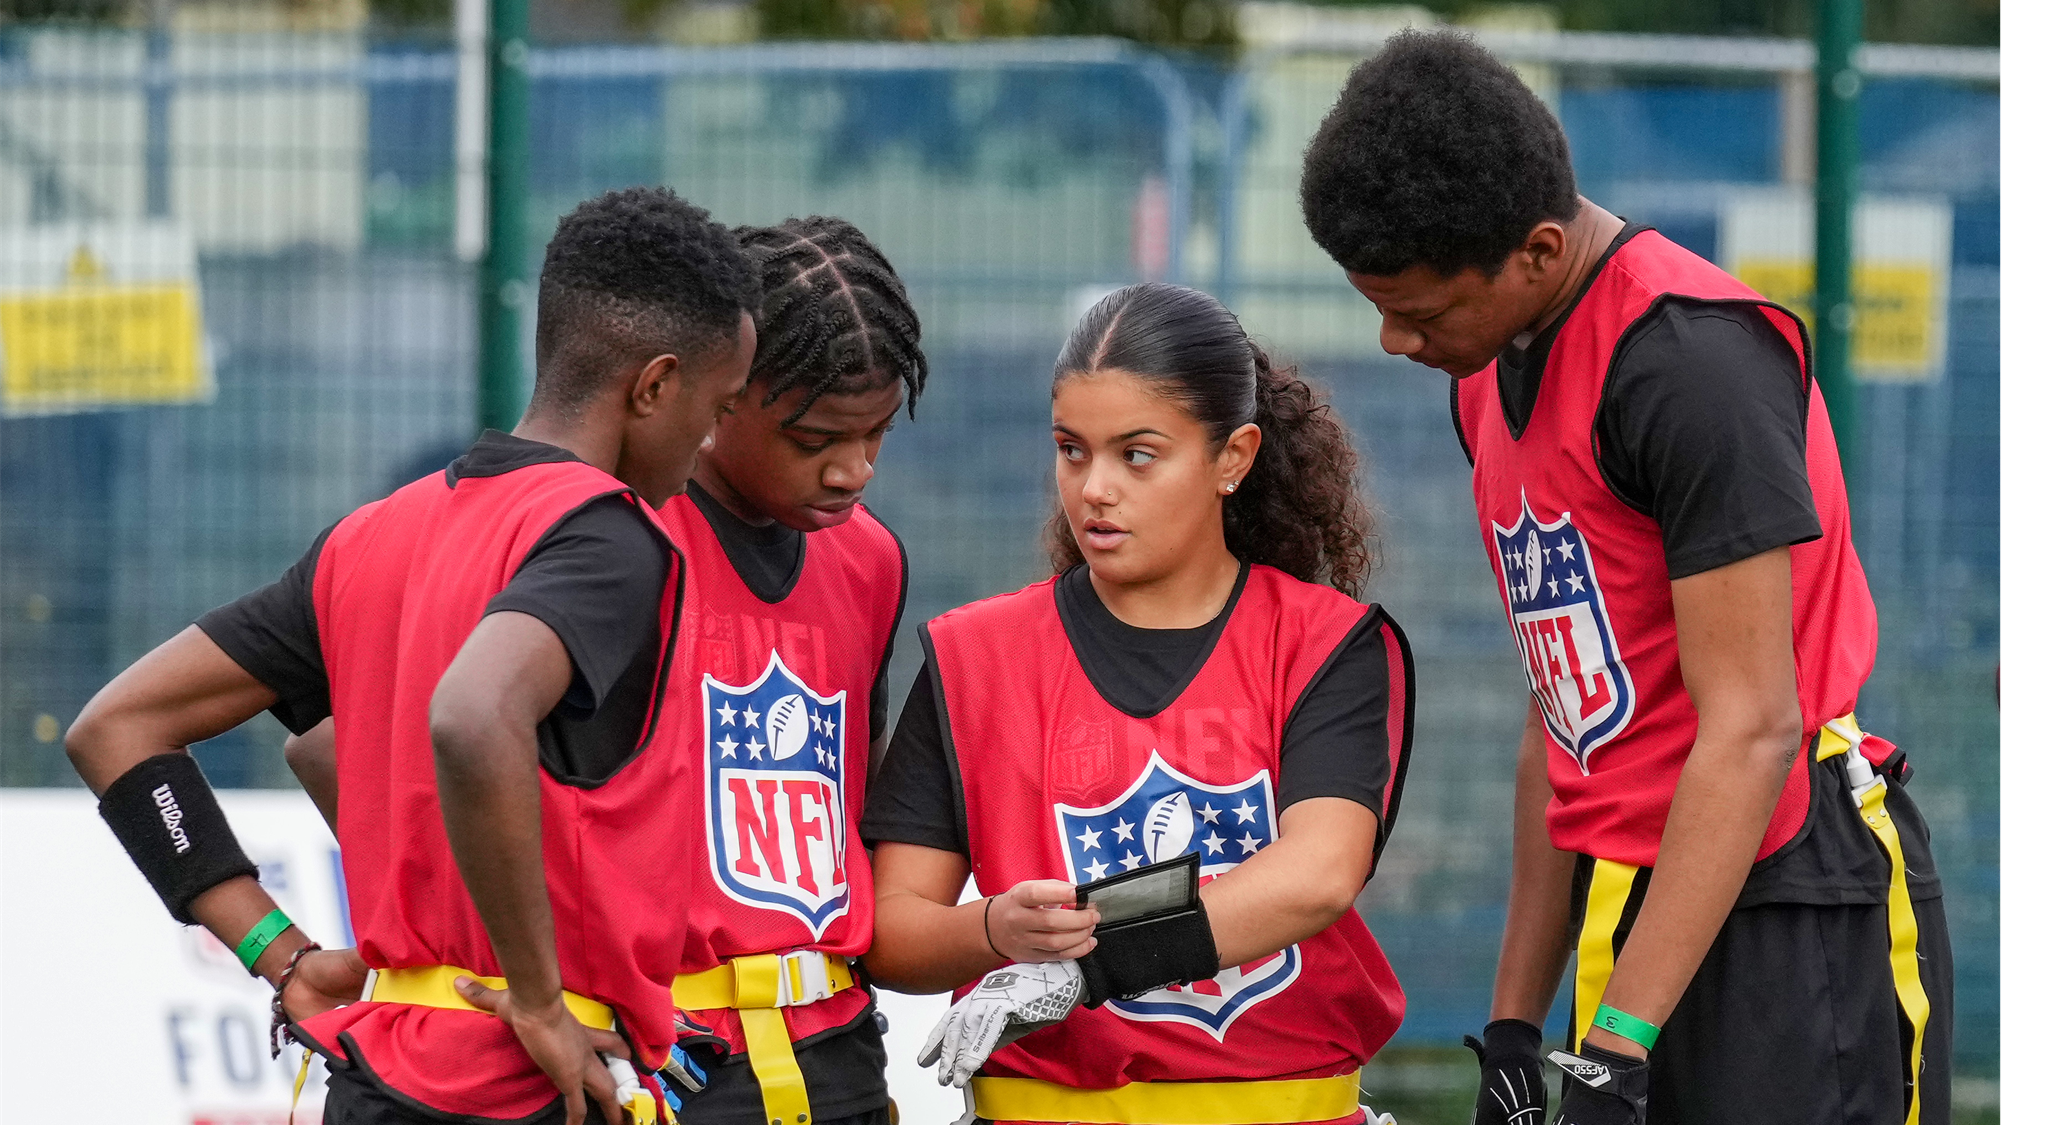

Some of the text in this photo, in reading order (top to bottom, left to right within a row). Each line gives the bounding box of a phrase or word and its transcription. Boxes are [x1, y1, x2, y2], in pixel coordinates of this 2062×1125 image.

[1520, 615, 1612, 736] NFL
[151, 783, 191, 854] Wilson
[728, 778, 847, 898] NFL
[973, 1004, 1002, 1053] Seibertron
[1574, 1064, 1605, 1075] AF550
